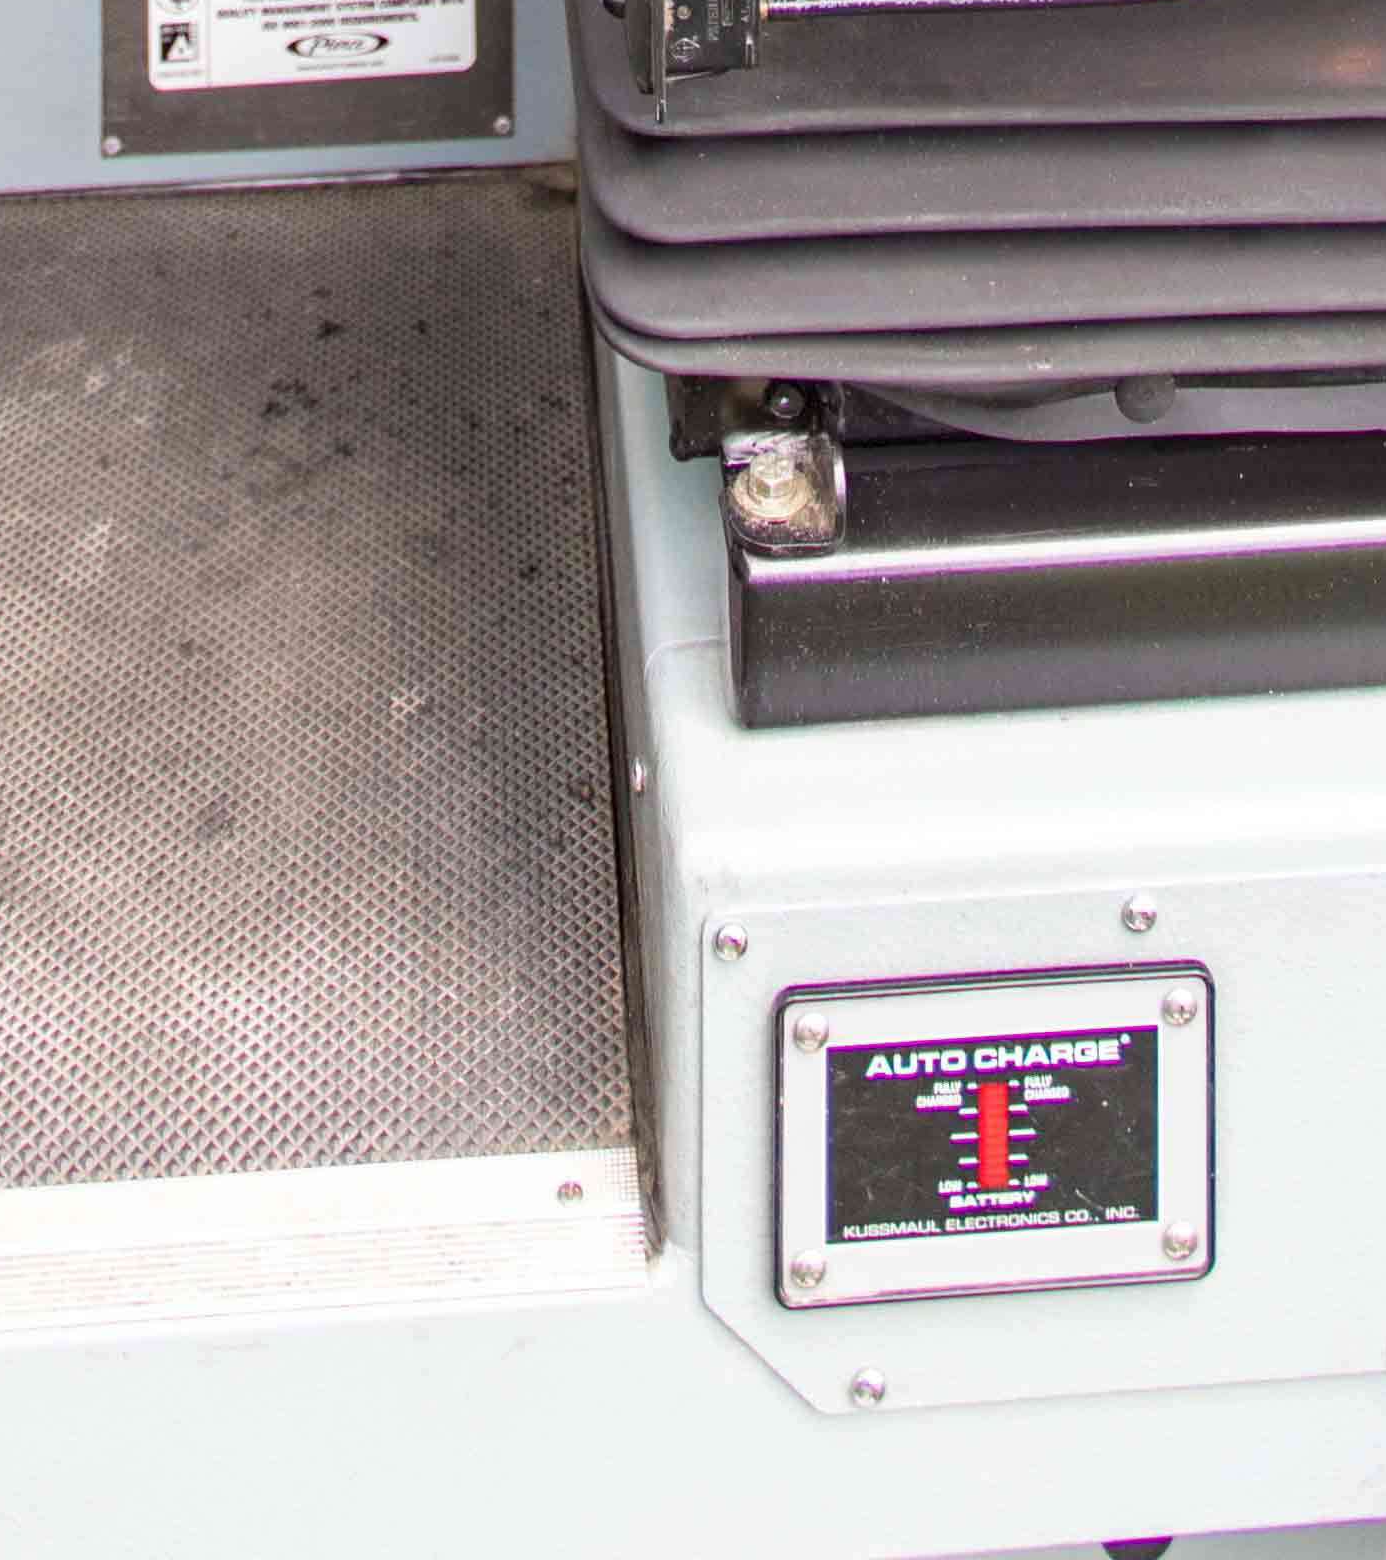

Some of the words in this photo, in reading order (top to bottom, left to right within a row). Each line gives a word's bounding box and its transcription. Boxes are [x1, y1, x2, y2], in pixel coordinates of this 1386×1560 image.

[864, 1048, 970, 1080] AUTO
[972, 1039, 1123, 1072] CHARGE
[938, 1179, 963, 1194] LOW
[1024, 1174, 1049, 1189] LOW
[949, 1190, 1036, 1211] BATTERY
[842, 1220, 941, 1240] KUSSMAUL
[945, 1210, 1060, 1232] ELECTRONICS
[1105, 1205, 1140, 1221] INC.
